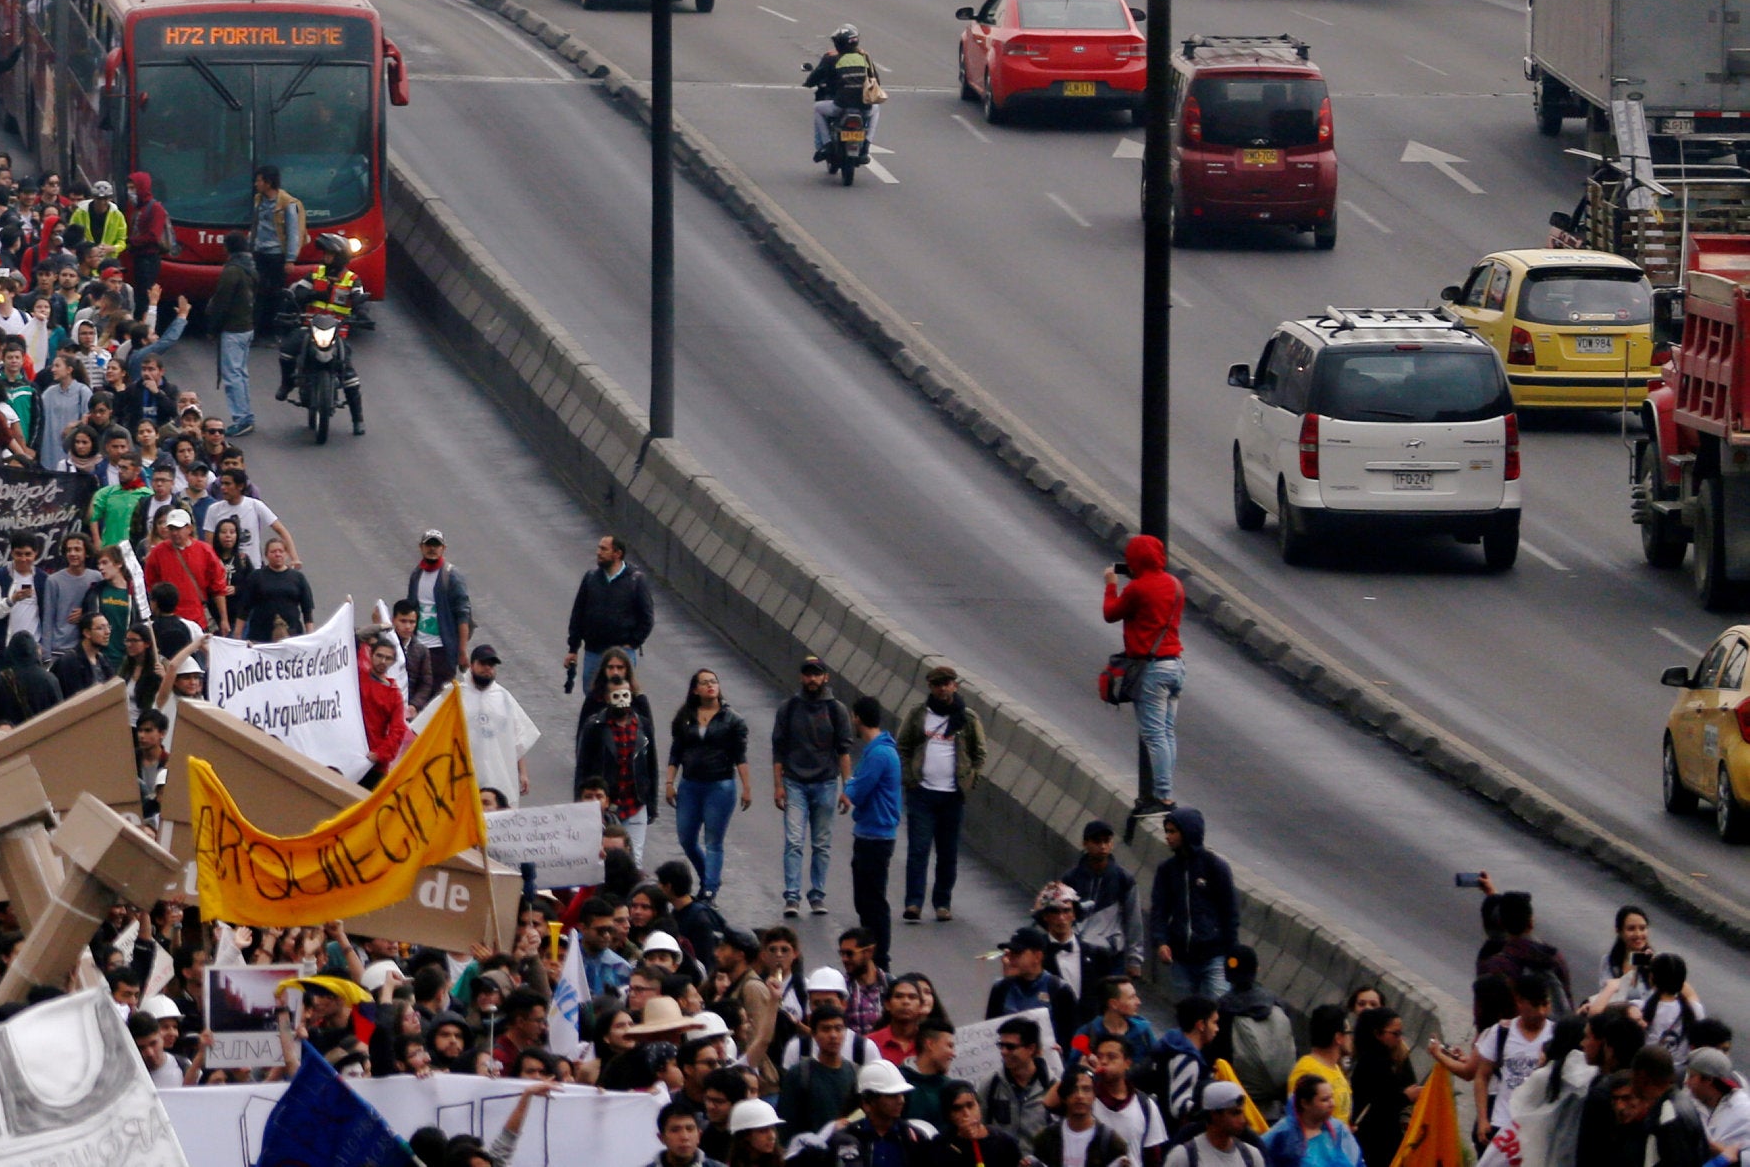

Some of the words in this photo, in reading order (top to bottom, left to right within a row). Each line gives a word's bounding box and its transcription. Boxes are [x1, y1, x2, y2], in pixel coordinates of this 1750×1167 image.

[165, 27, 205, 45] H72
[210, 27, 286, 45] PORTAL
[292, 27, 343, 45] USME
[217, 652, 273, 709] ¿Dónde
[276, 653, 304, 681] está
[418, 871, 471, 912] de
[208, 1039, 272, 1061] RUINA
